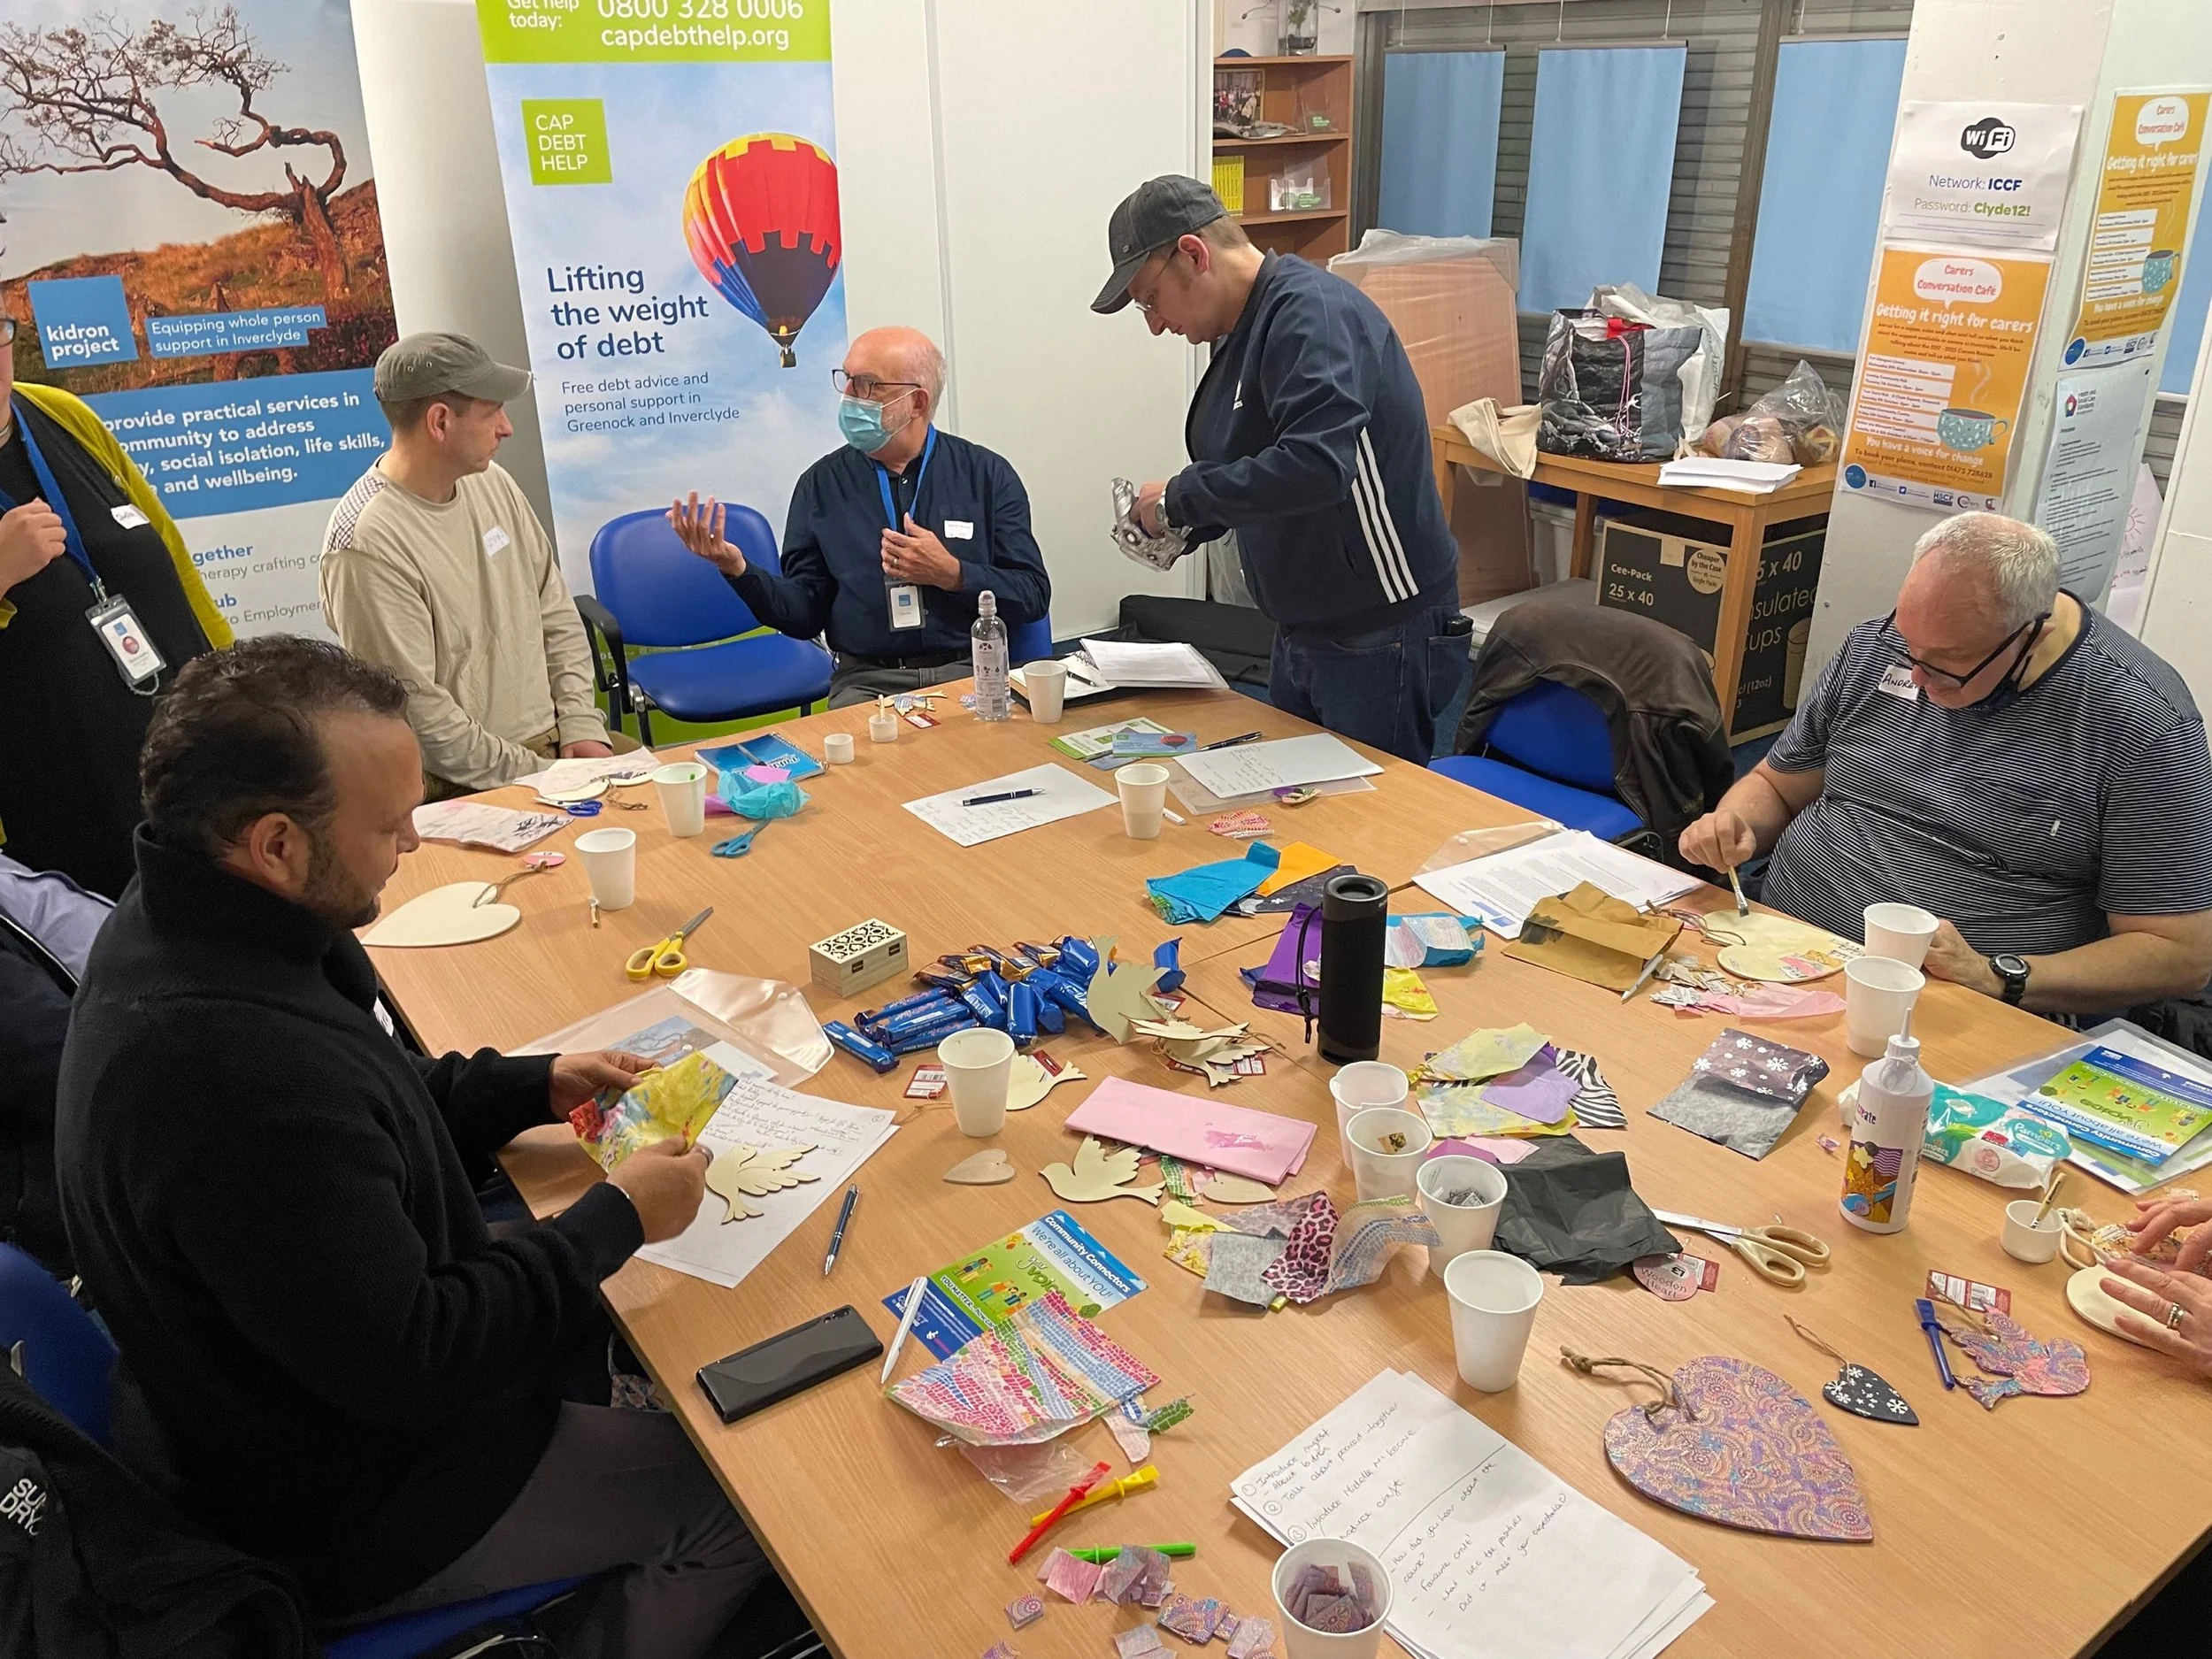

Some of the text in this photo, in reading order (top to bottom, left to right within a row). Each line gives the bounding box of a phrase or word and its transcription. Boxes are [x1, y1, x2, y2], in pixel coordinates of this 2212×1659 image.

[507, 0, 579, 12] Get help
[598, 0, 803, 19] 0800 328 0006
[509, 12, 563, 31] today:
[601, 24, 789, 50] capdebthelp.org
[535, 114, 574, 131] CAP
[538, 134, 587, 151] DEBT
[541, 154, 588, 171] HELP
[1929, 175, 2023, 191] Network: ICCF
[1915, 198, 2032, 217] Password: Clyde12!
[547, 265, 644, 294] Lifting
[1945, 265, 1974, 277] Carers
[1917, 280, 1973, 294] Conversation
[550, 295, 710, 326] the weight
[1876, 303, 2033, 334] Getting it right for carers
[46, 323, 110, 342] kidron
[151, 312, 320, 338] Equipping whole person
[51, 337, 119, 361] project
[155, 329, 301, 354] support in Inverclyde
[557, 331, 665, 360] of debt
[562, 372, 709, 394] Free debt advice and
[181, 400, 261, 427] practical
[266, 395, 339, 414] services
[343, 392, 359, 406] in
[565, 392, 701, 416] personal support in
[219, 427, 239, 442] to
[245, 419, 315, 441] address
[567, 407, 740, 433] Greenock and Inverclyde
[160, 451, 213, 472] social
[219, 443, 301, 465] isolation,
[304, 439, 333, 454] life
[338, 433, 386, 451] skills,
[1866, 436, 1880, 448] You
[1882, 440, 1902, 452] have
[1911, 446, 1933, 457] voice
[1936, 449, 1950, 459] for
[1952, 451, 1984, 467] change
[164, 466, 297, 495] and wellbeing.
[1933, 492, 1954, 501] HSCP
[193, 545, 253, 566] gether
[253, 556, 305, 573] crafting
[1769, 561, 1778, 577] x
[1783, 550, 1802, 572] 40
[1610, 564, 1652, 582] Cee-Pack
[215, 594, 237, 608] ub
[1609, 583, 1654, 606] 25 x 40
[1744, 626, 1782, 654] ups
[2015, 1122, 2062, 1151] Pampers
[1032, 1226, 1113, 1299] We're all about YOU!
[1045, 1217, 1131, 1293] Community Connectors
[941, 1275, 954, 1289] YOU
[1640, 1265, 1687, 1294] Wooden
[1671, 1265, 1685, 1278] £1
[1646, 1279, 1678, 1299] Heart
[1256, 1457, 1298, 1487] Introduce
[1481, 1463, 1496, 1474] the
[1306, 1499, 1342, 1531] Introduce
[1458, 1594, 1472, 1612] Did
